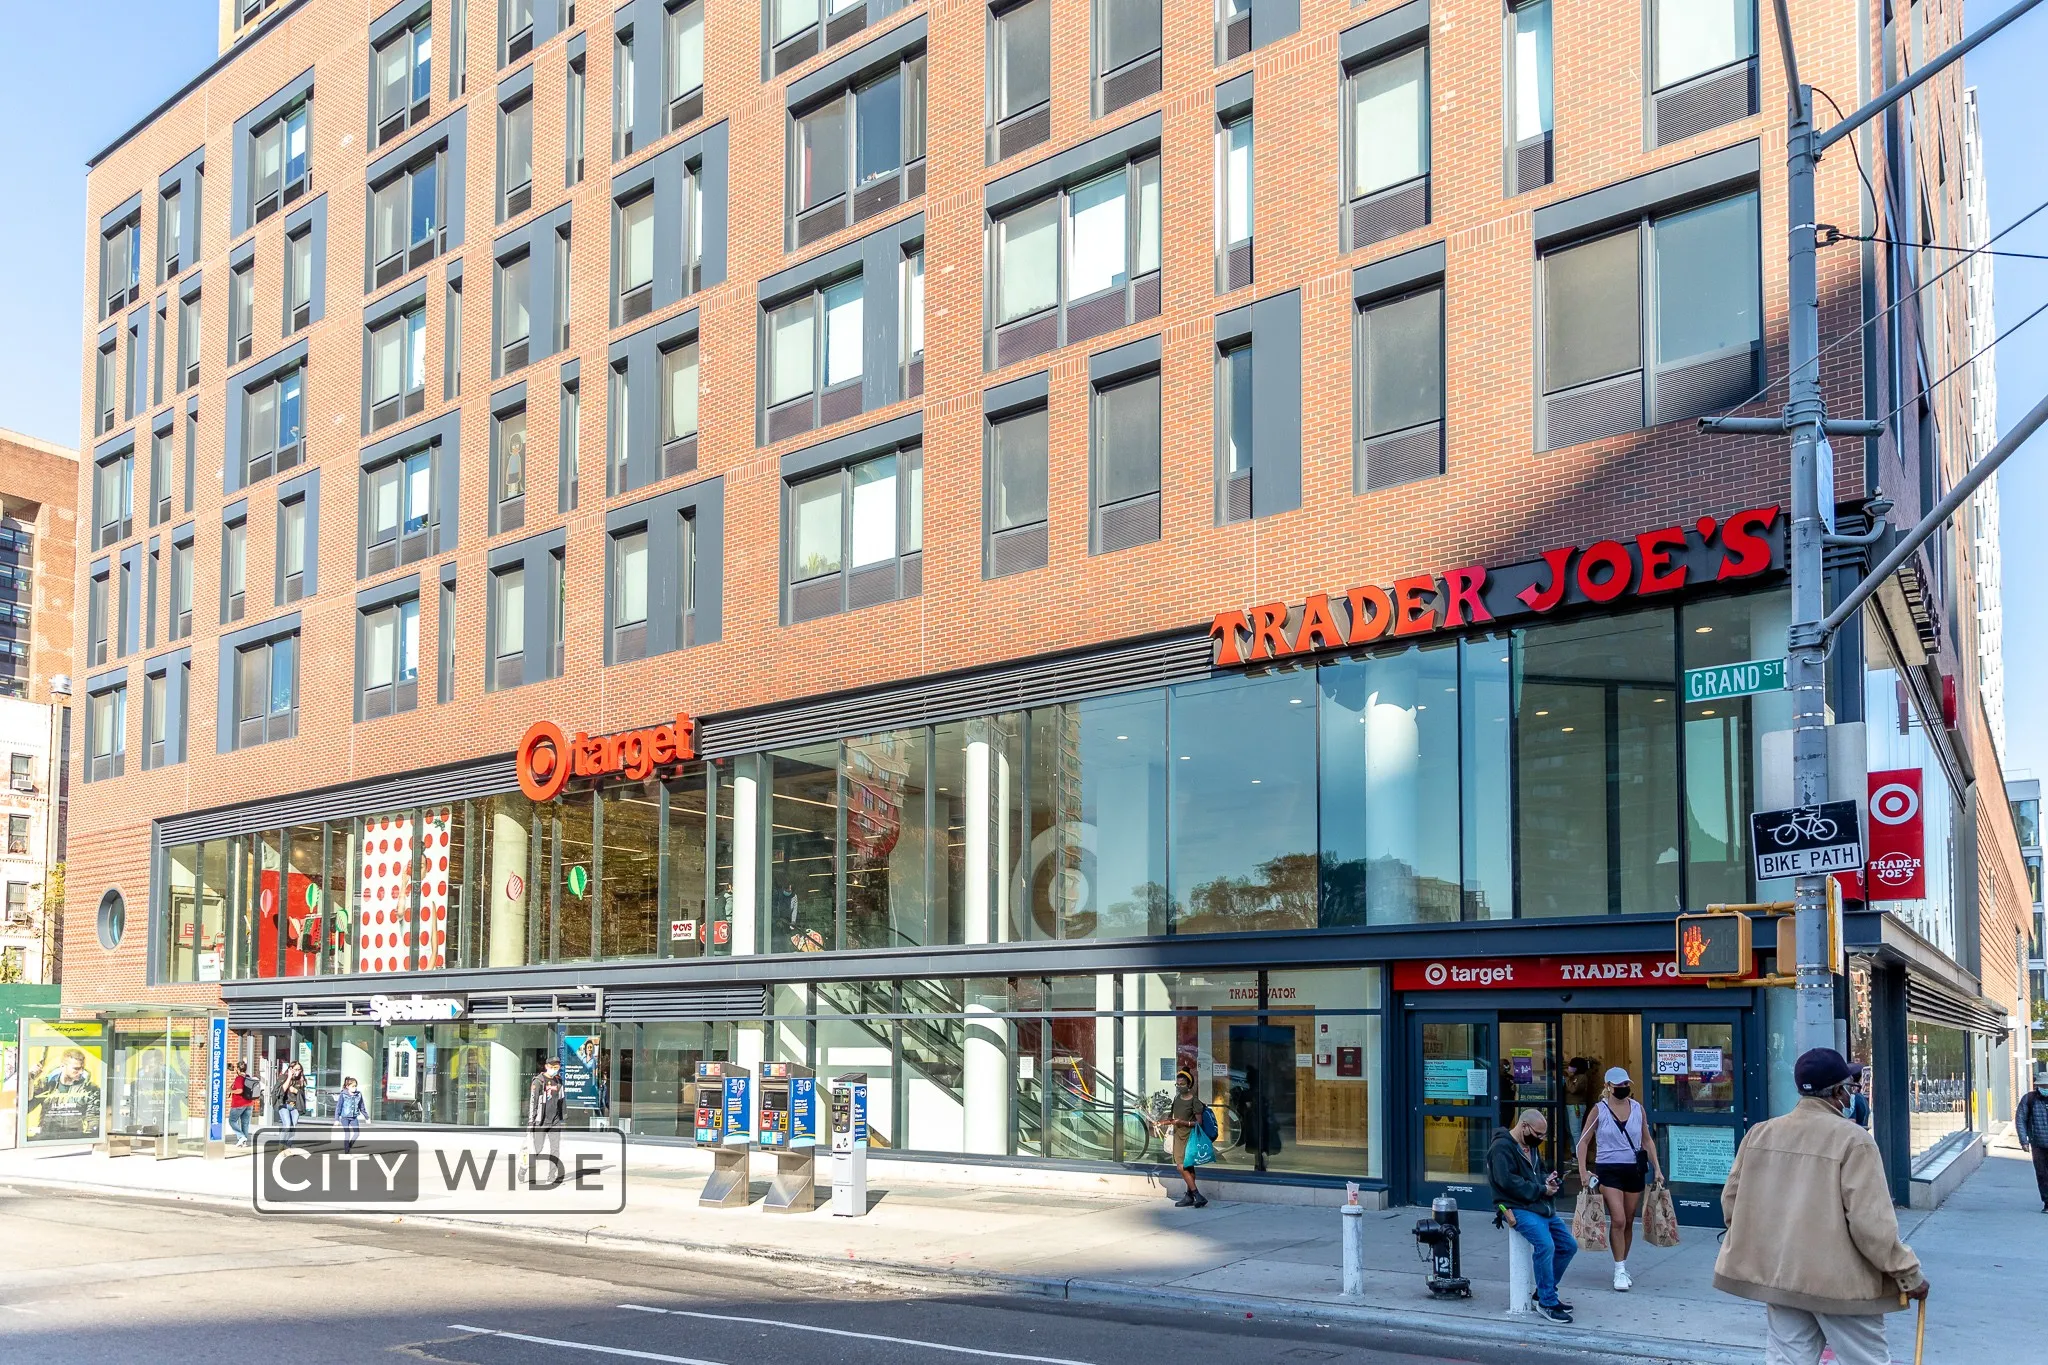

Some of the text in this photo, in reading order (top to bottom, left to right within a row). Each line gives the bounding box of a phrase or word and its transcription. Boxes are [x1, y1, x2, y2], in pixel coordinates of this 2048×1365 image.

[1209, 504, 1782, 666] TRADER JOE'S
[1690, 661, 1781, 698] GRAND ST
[570, 711, 695, 781] target
[1763, 846, 1854, 873] BIKE PATH
[1869, 857, 1921, 870] TRADER
[1876, 867, 1914, 879] JOE'S
[678, 923, 693, 932] CVS
[1450, 963, 1514, 986] target
[1560, 962, 1643, 980] TRADER
[213, 1027, 222, 1050] Grand
[213, 1050, 221, 1071] Street
[212, 1079, 220, 1104] Clinton
[212, 1104, 220, 1125] Street
